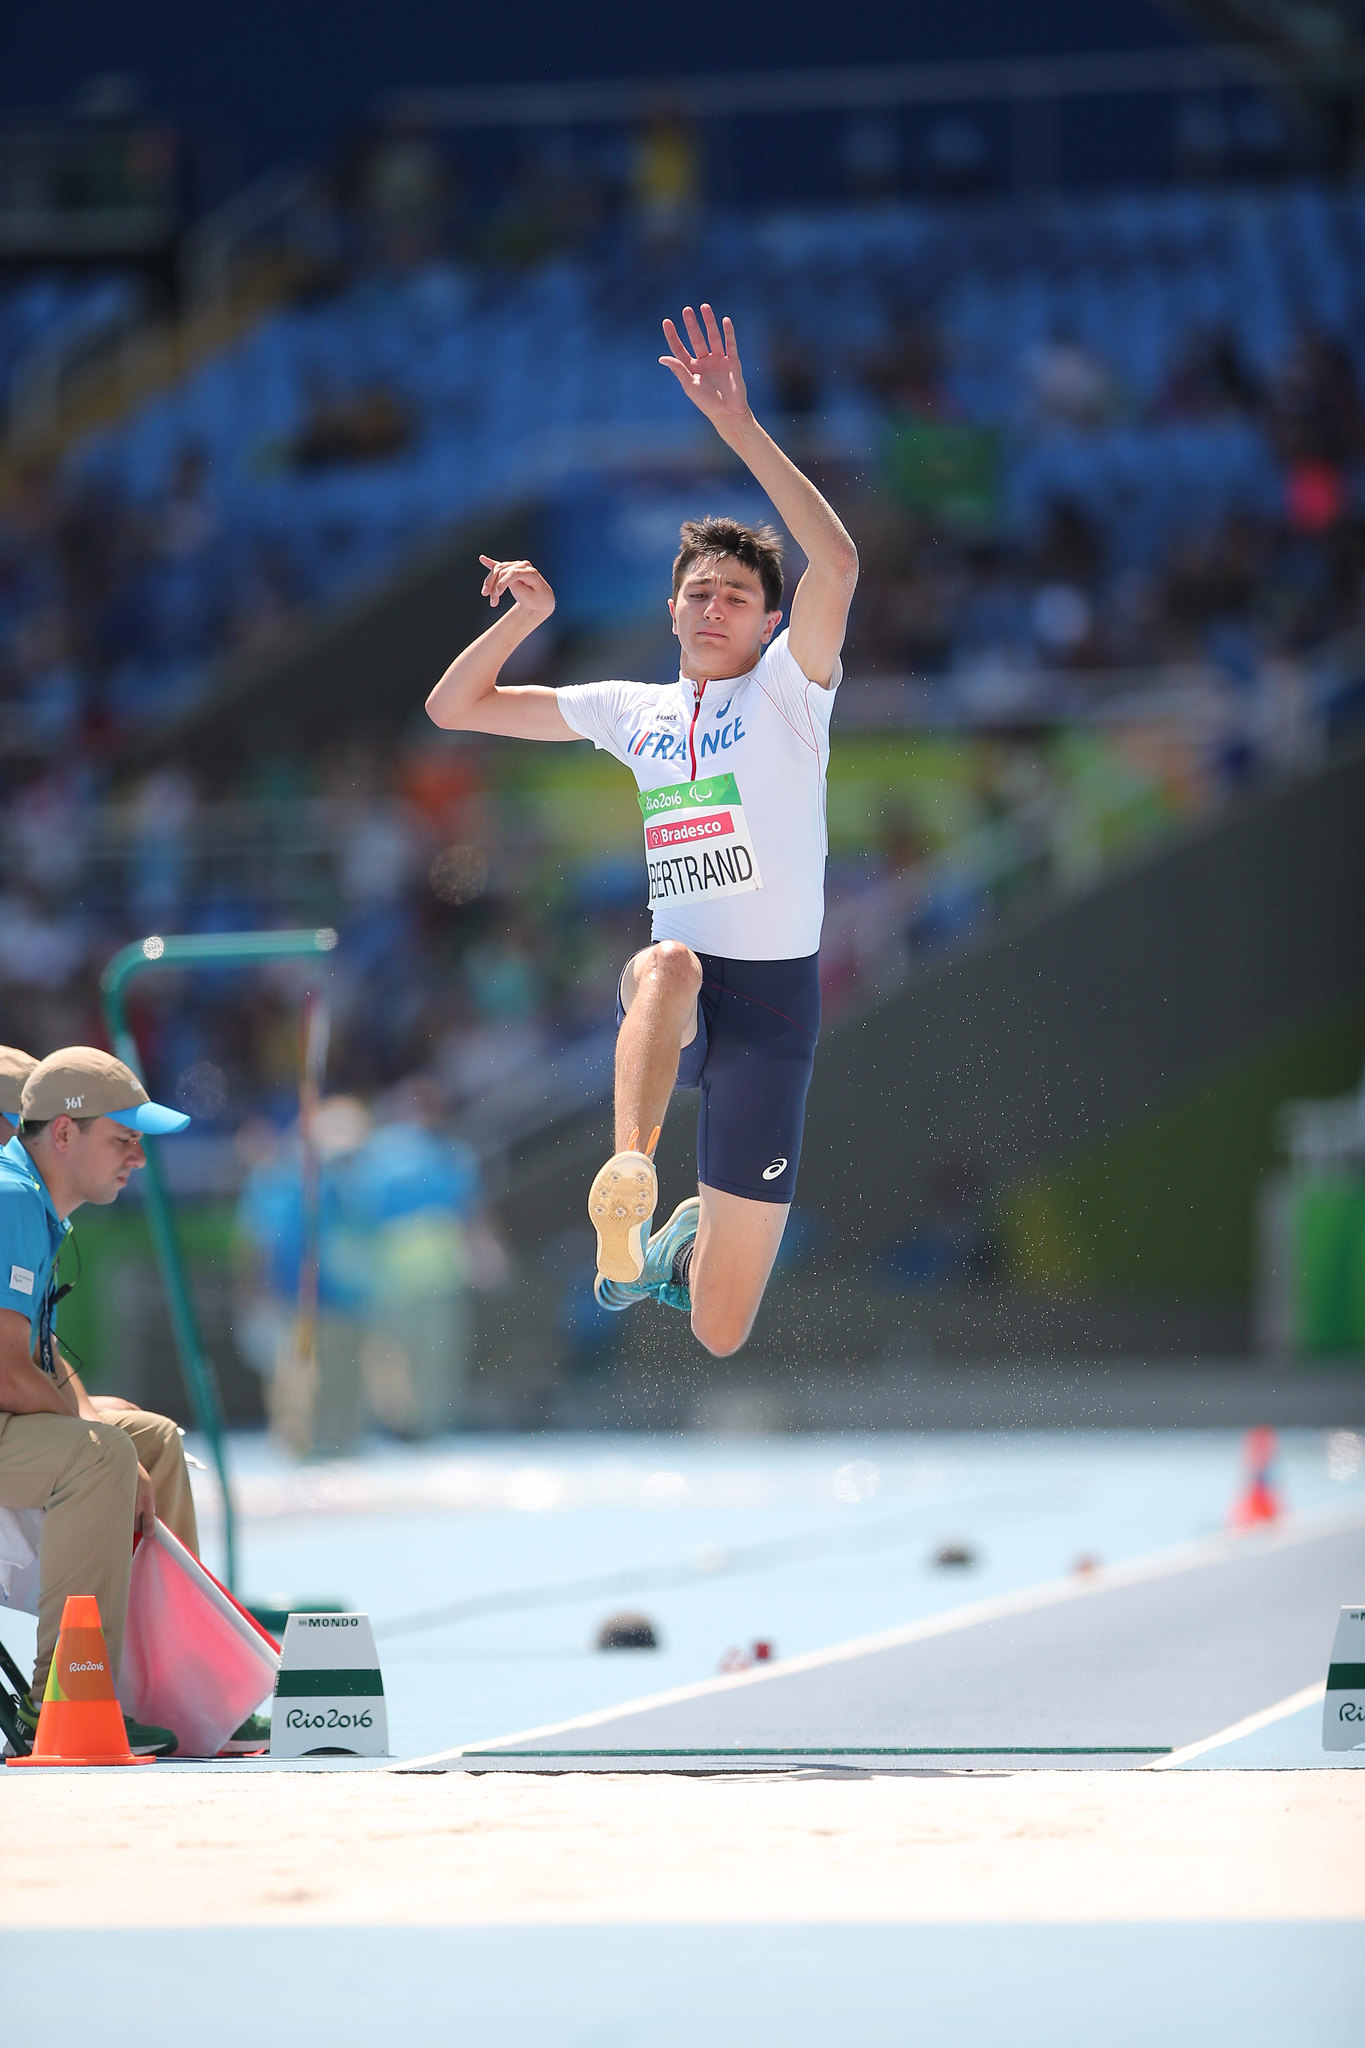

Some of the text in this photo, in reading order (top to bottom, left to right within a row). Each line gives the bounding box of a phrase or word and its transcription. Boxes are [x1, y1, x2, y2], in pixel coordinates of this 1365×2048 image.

[638, 715, 746, 761] FRANCE
[660, 820, 722, 843] Bradesco
[649, 845, 753, 900] BERTRAND
[308, 1617, 359, 1628] MONDO
[69, 1660, 105, 1673] Rio2016
[286, 1708, 373, 1729] Rio2016
